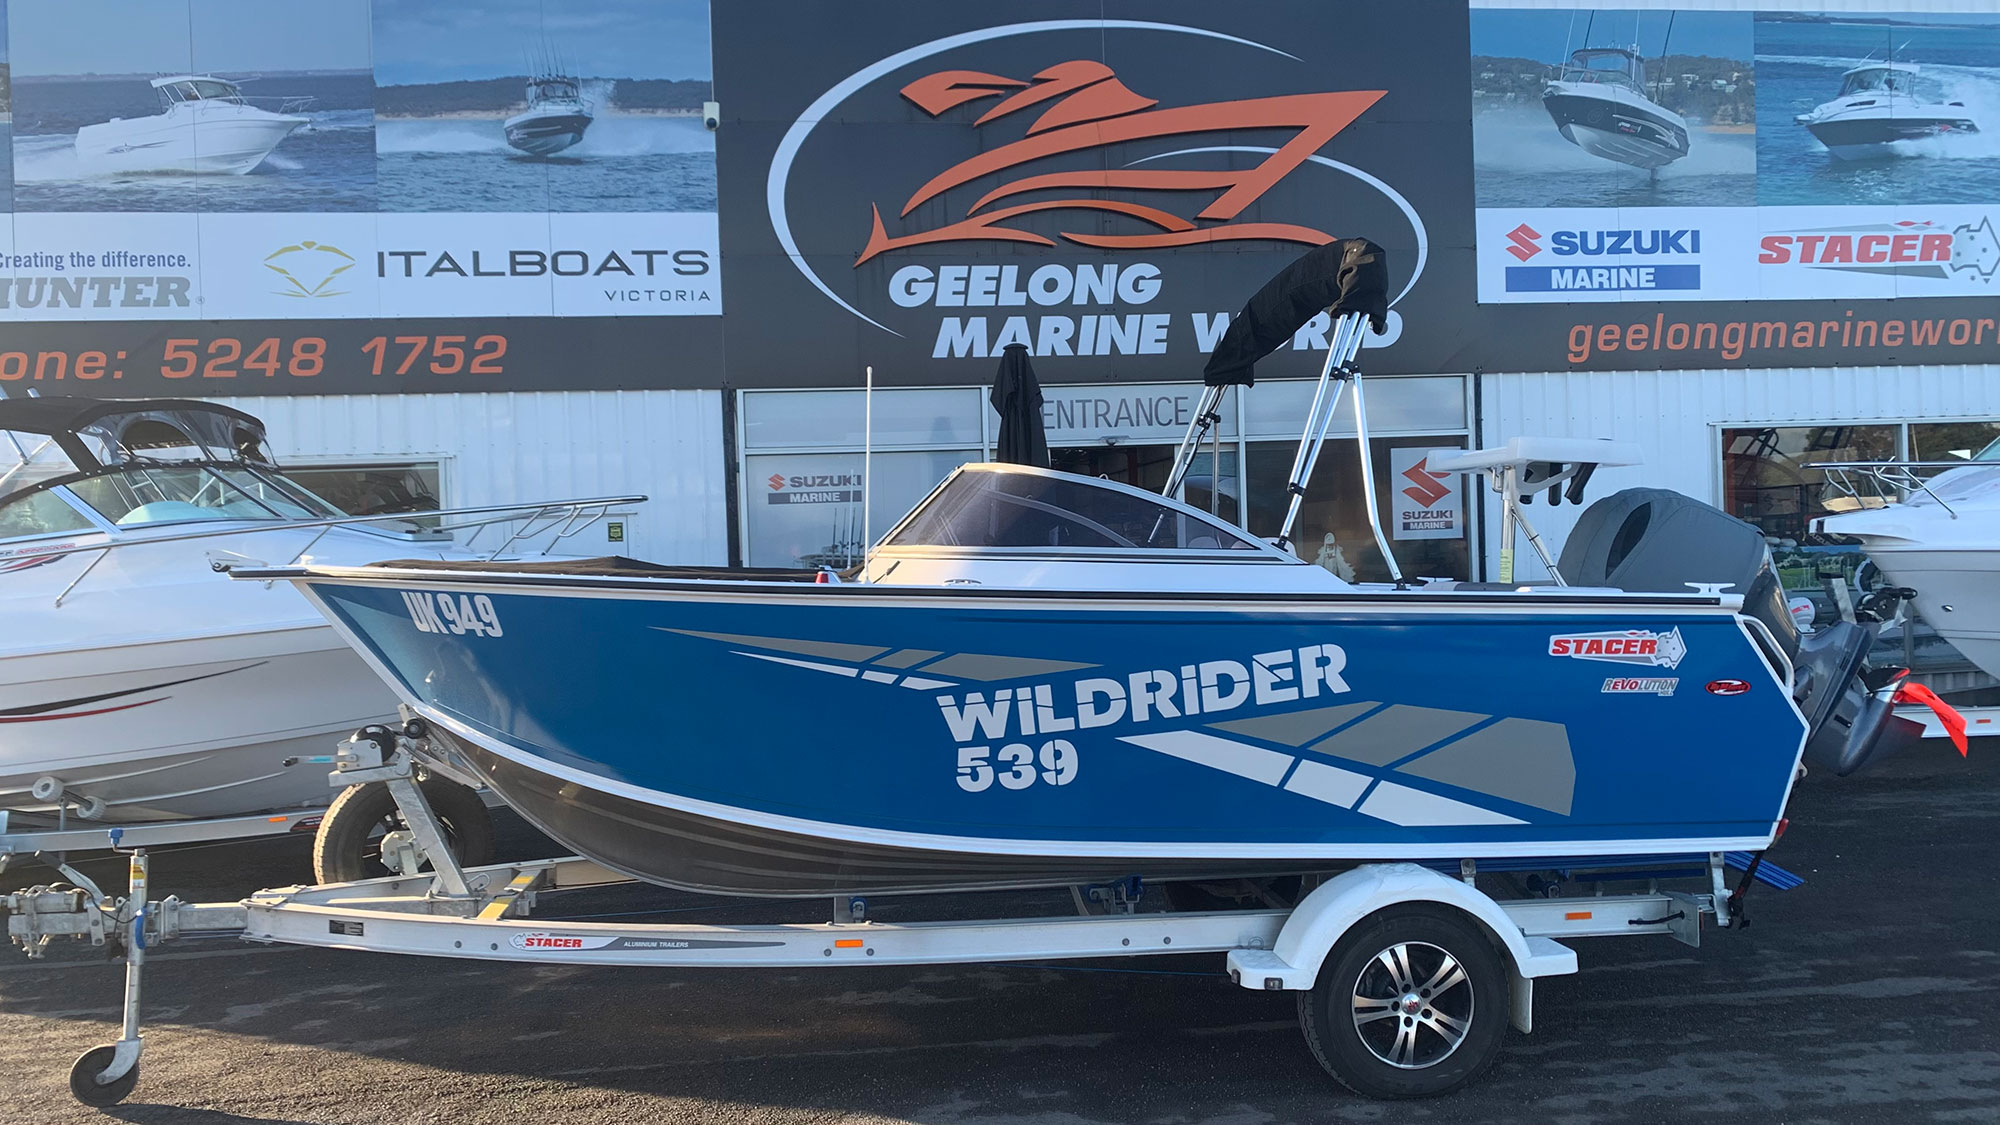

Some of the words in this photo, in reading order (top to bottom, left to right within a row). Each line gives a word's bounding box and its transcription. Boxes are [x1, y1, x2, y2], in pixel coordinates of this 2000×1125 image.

[1551, 229, 1700, 256] SUZUKI
[1758, 234, 1953, 264] STACER
[69, 250, 95, 268] the
[101, 250, 191, 268] difference.
[377, 250, 710, 277] ITALBOATS
[888, 262, 1163, 308] GEELONG
[1551, 267, 1656, 289] MARINE
[604, 289, 711, 302] VICTORIA
[931, 313, 1171, 359] MARINE
[1191, 310, 1404, 354] WRD
[0, 351, 127, 381] one:
[160, 336, 327, 379] 5248
[361, 334, 508, 376] 1752
[1042, 396, 1190, 430] ENTRANCE
[789, 474, 862, 488] SUZUKI
[789, 492, 841, 503] MARINE
[1402, 510, 1453, 520] SUZUKI
[1410, 521, 1446, 530] MARINE
[1551, 639, 1658, 655] STACER
[956, 739, 1079, 792] 539
[525, 938, 582, 948] STACER
